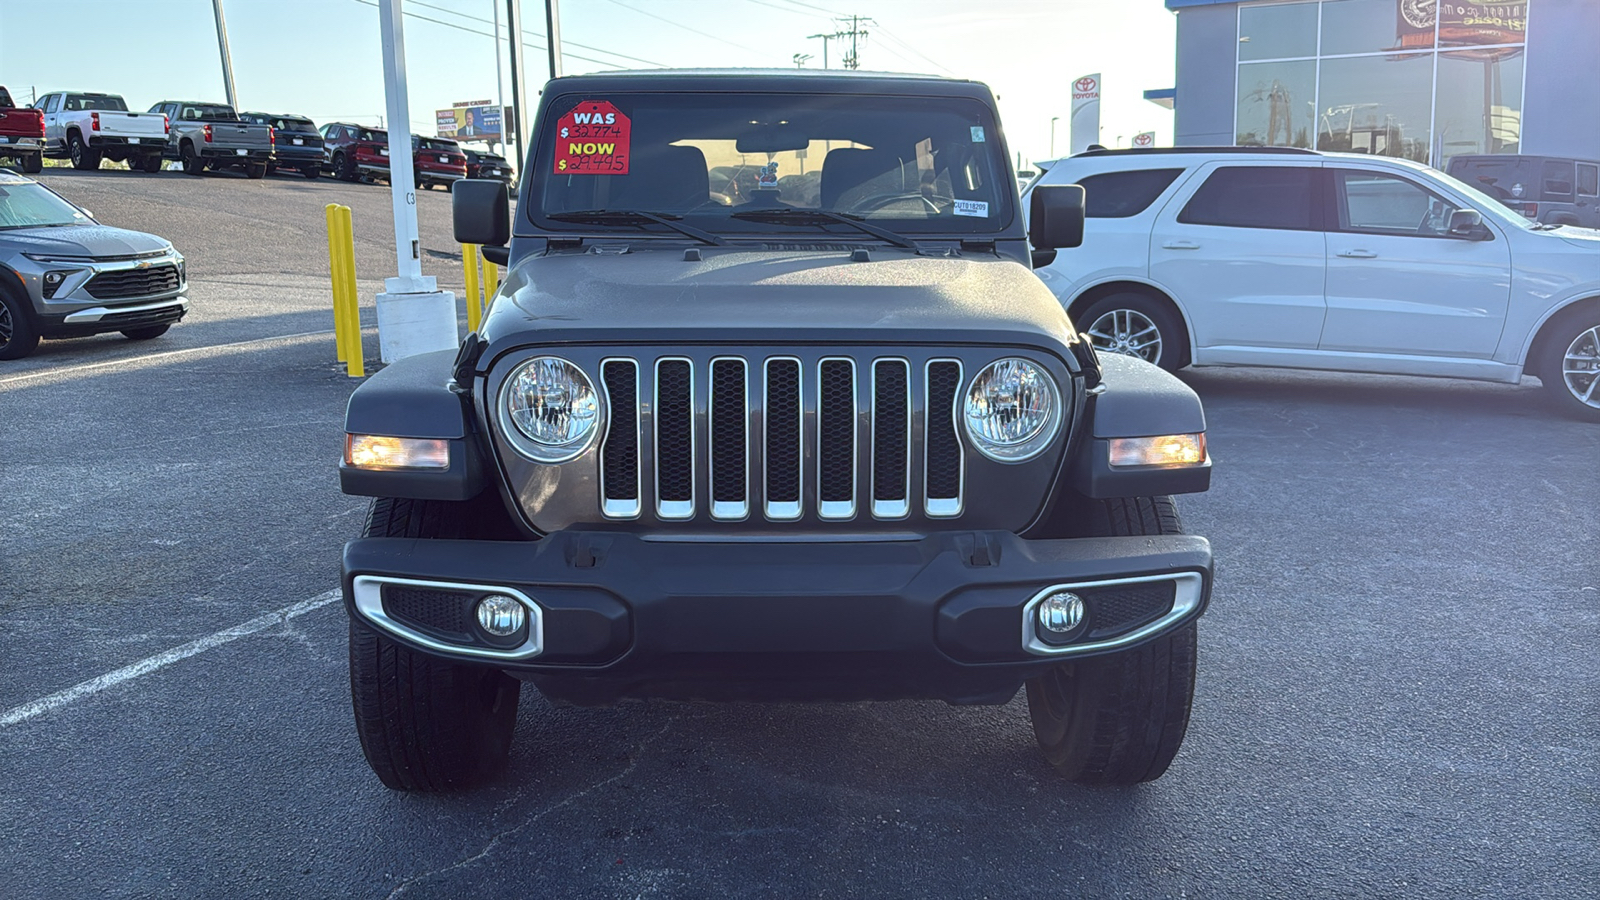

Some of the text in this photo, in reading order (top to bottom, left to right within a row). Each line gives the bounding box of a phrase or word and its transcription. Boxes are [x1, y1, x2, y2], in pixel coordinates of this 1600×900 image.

[574, 112, 616, 125] WAS
[569, 143, 616, 155] NOW
[406, 192, 415, 205] C3
